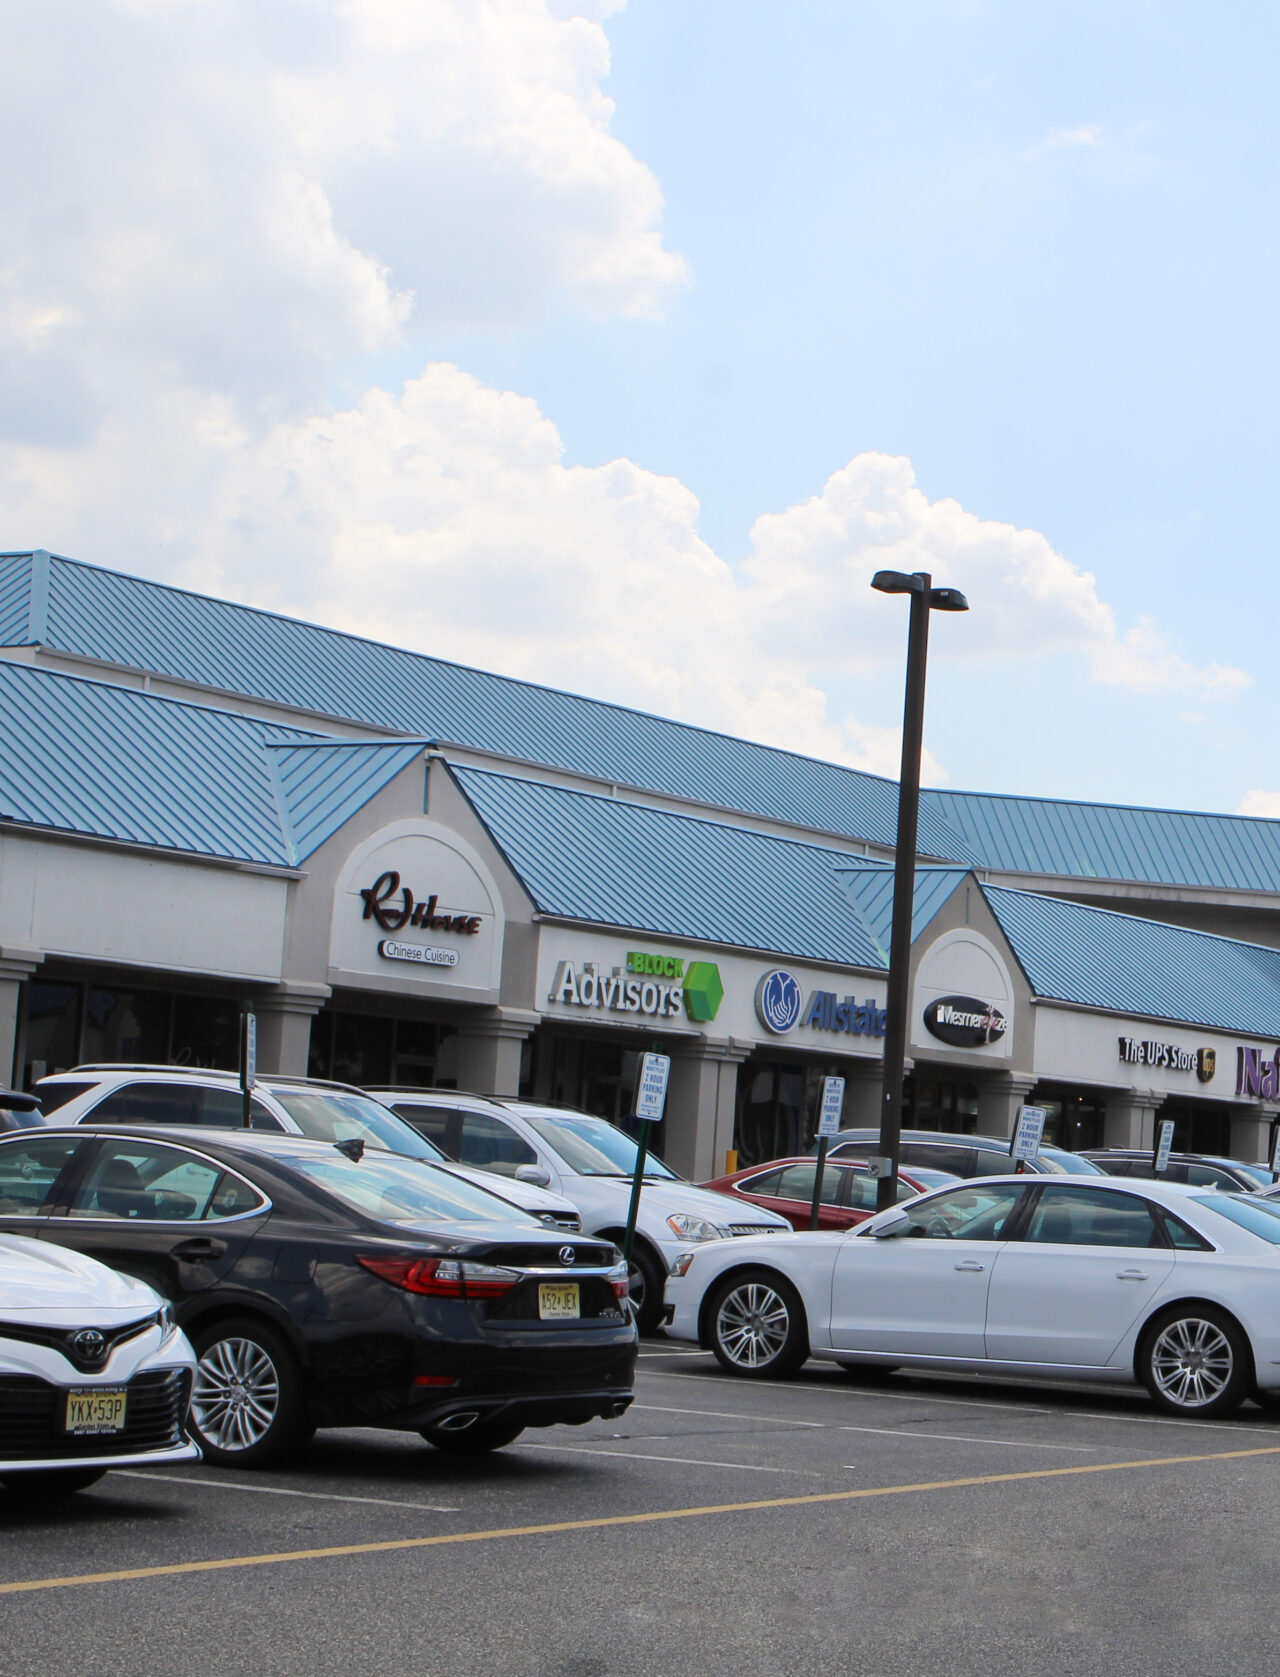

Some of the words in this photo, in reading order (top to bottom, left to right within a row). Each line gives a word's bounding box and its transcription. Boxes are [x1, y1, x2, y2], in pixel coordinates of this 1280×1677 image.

[386, 942, 422, 959] Chinese
[424, 948, 456, 964] Cuisine
[630, 952, 685, 977] BLOCK
[555, 960, 684, 1017] Advisors
[1124, 1037, 1145, 1063] The
[1147, 1041, 1170, 1067] UPS
[1171, 1046, 1198, 1071] Store
[643, 1083, 663, 1094] PARKING
[1019, 1131, 1038, 1140] PARKING
